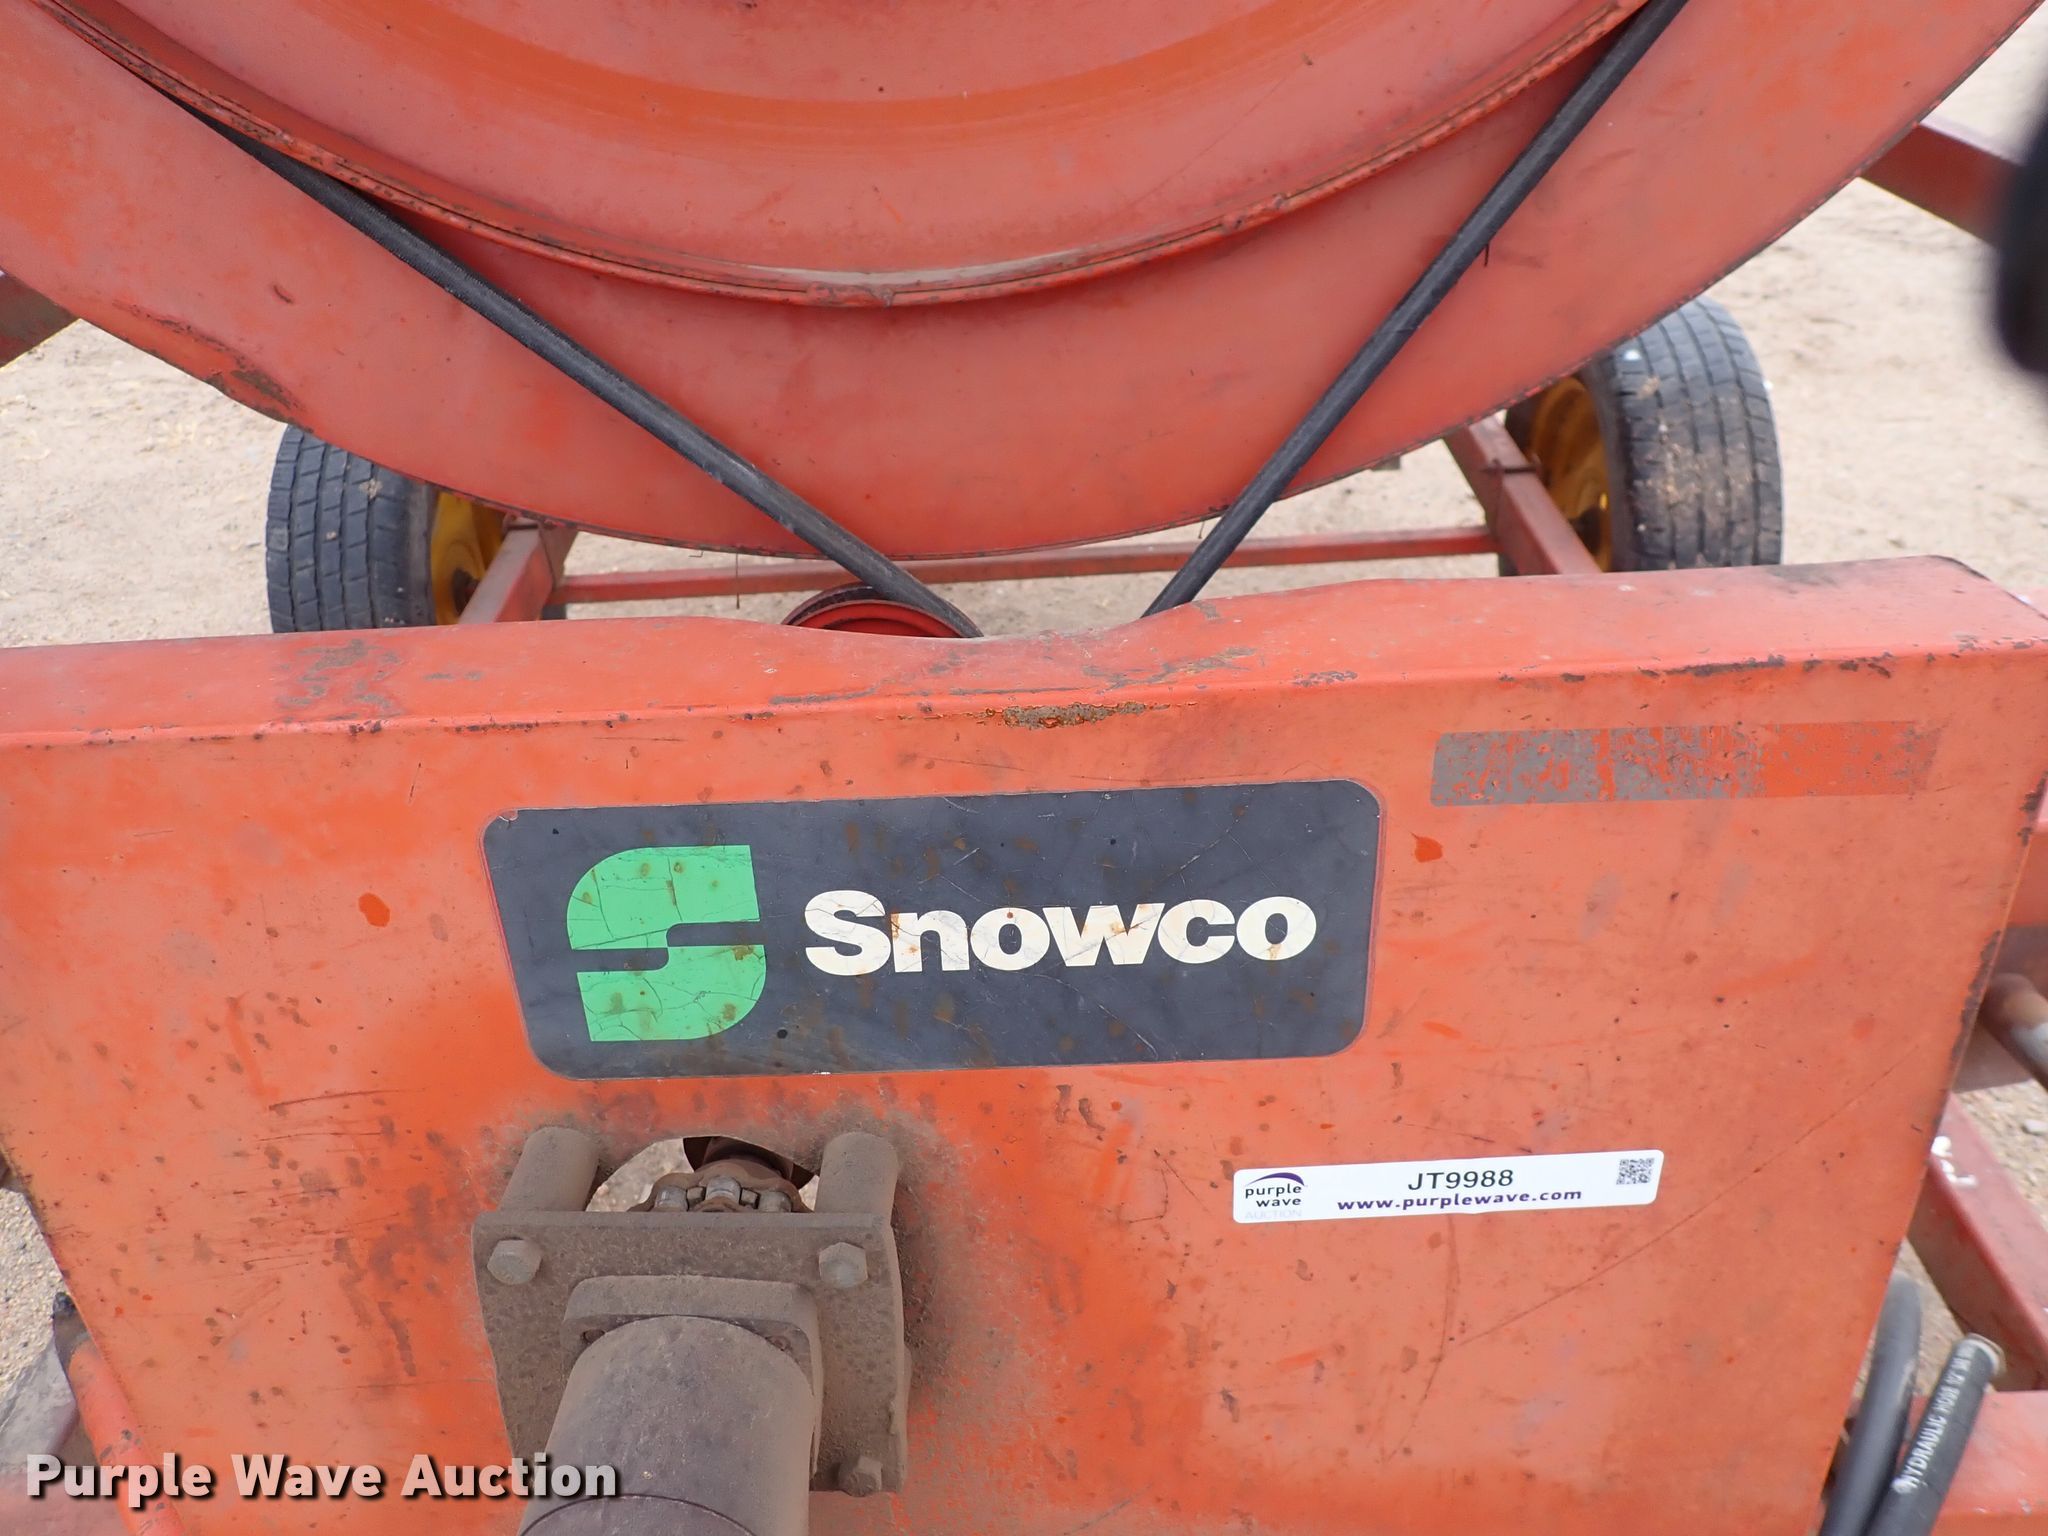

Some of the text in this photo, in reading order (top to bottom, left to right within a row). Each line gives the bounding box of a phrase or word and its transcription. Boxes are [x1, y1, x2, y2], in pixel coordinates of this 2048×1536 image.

[804, 889, 1317, 977] Snowco
[1408, 1169, 1514, 1191] JT9988
[1245, 1183, 1302, 1199] purple
[1337, 1188, 1582, 1211] www.purplewave.com
[1255, 1198, 1302, 1208] wave
[1245, 1209, 1303, 1220] AUCTION
